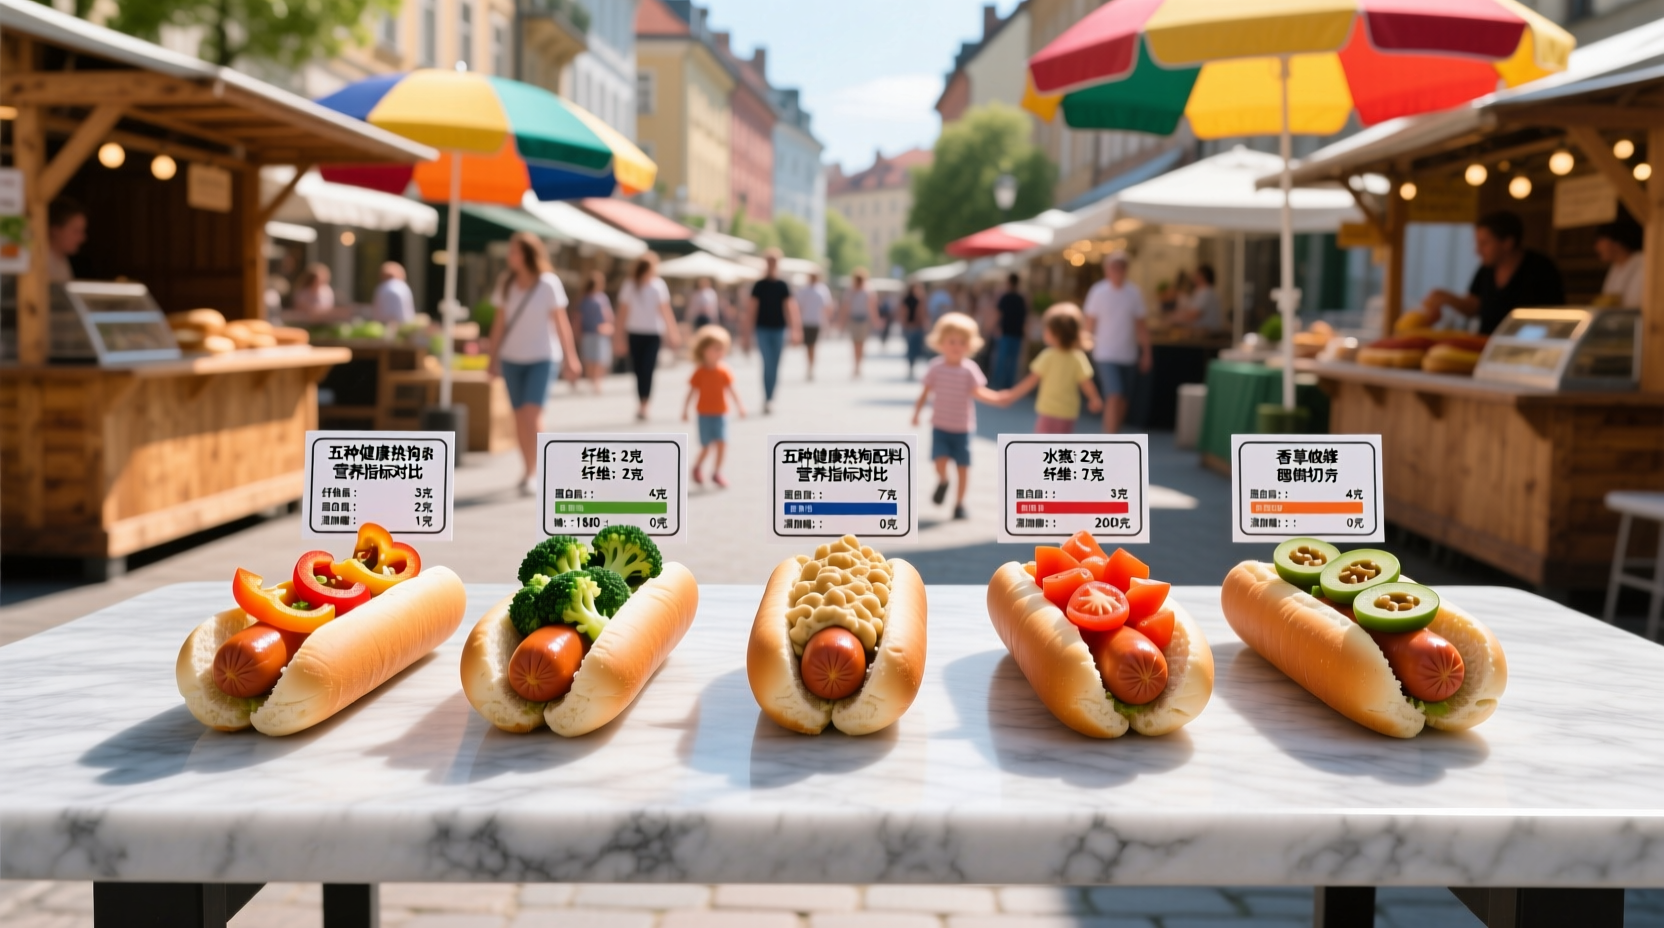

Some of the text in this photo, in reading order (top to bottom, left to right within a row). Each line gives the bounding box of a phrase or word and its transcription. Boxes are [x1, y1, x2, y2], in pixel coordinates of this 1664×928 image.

[621, 449, 643, 463] 2克
[1080, 449, 1104, 464] 2克
[622, 468, 644, 481] 2克
